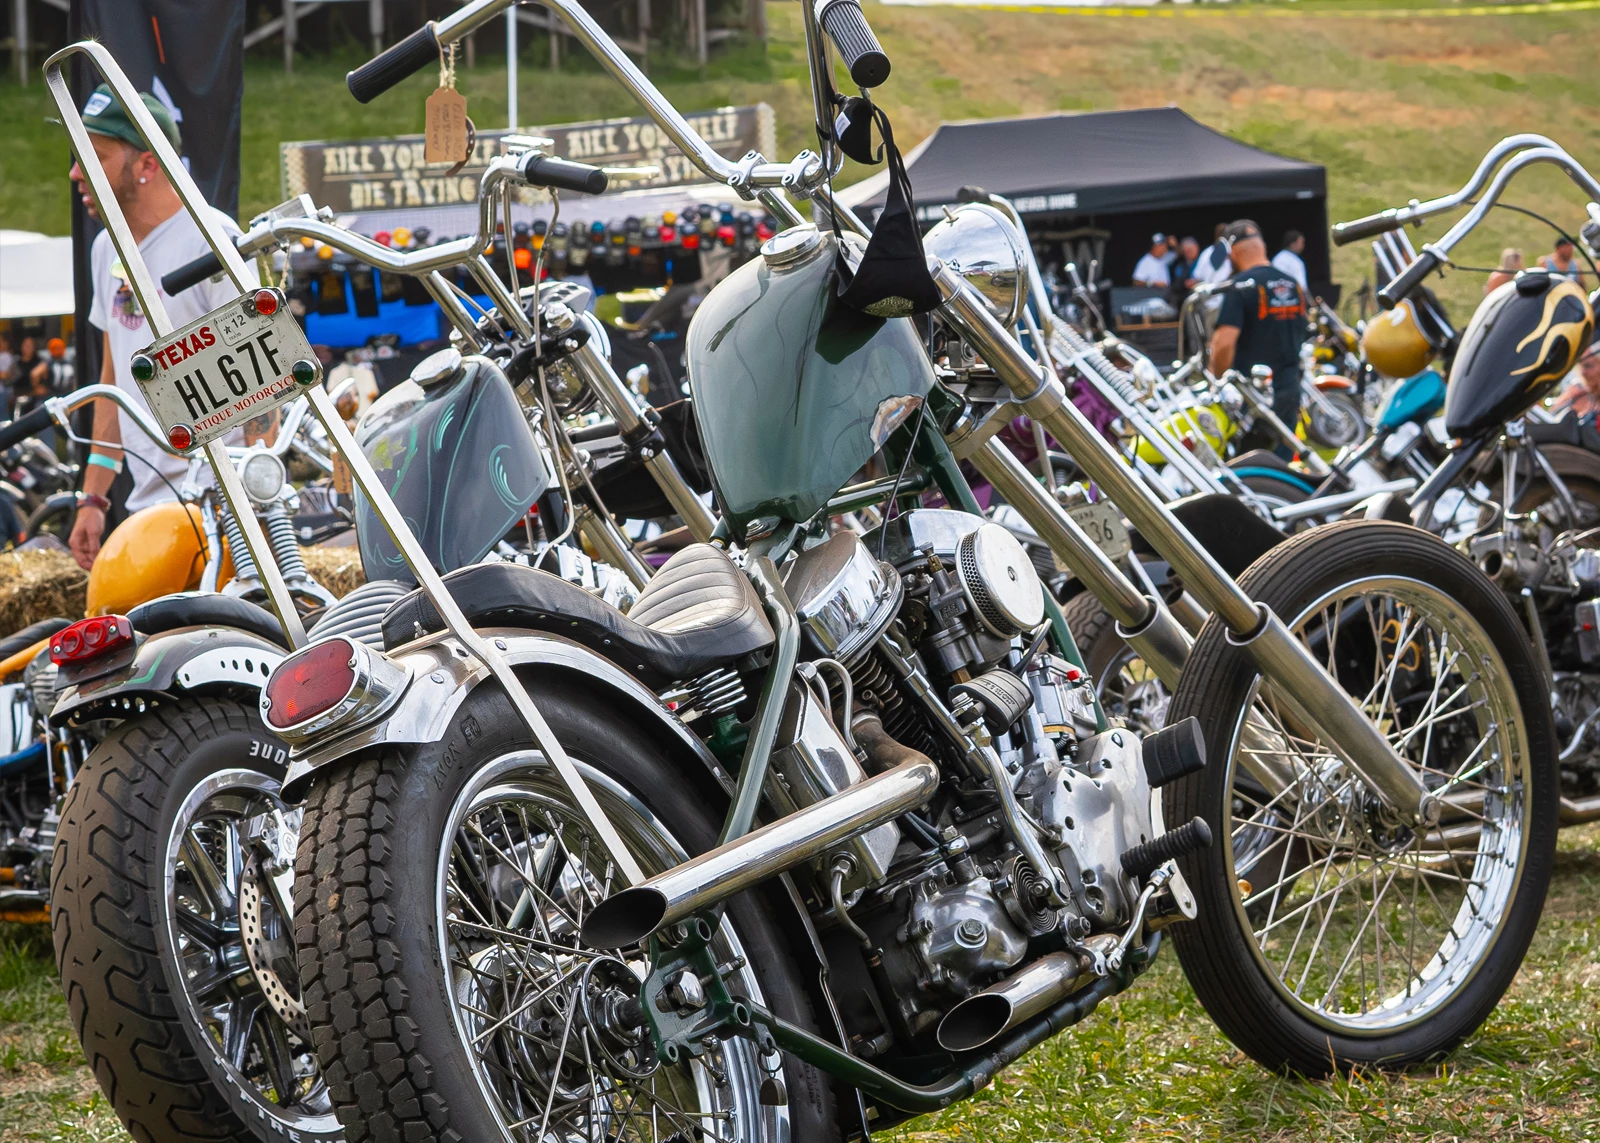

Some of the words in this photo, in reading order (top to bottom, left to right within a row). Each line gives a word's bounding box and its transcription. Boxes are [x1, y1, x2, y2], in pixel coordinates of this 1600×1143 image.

[231, 314, 247, 328] 12
[153, 326, 216, 371] TEXAS
[174, 330, 282, 421] HL67F
[1081, 518, 1114, 544] 36
